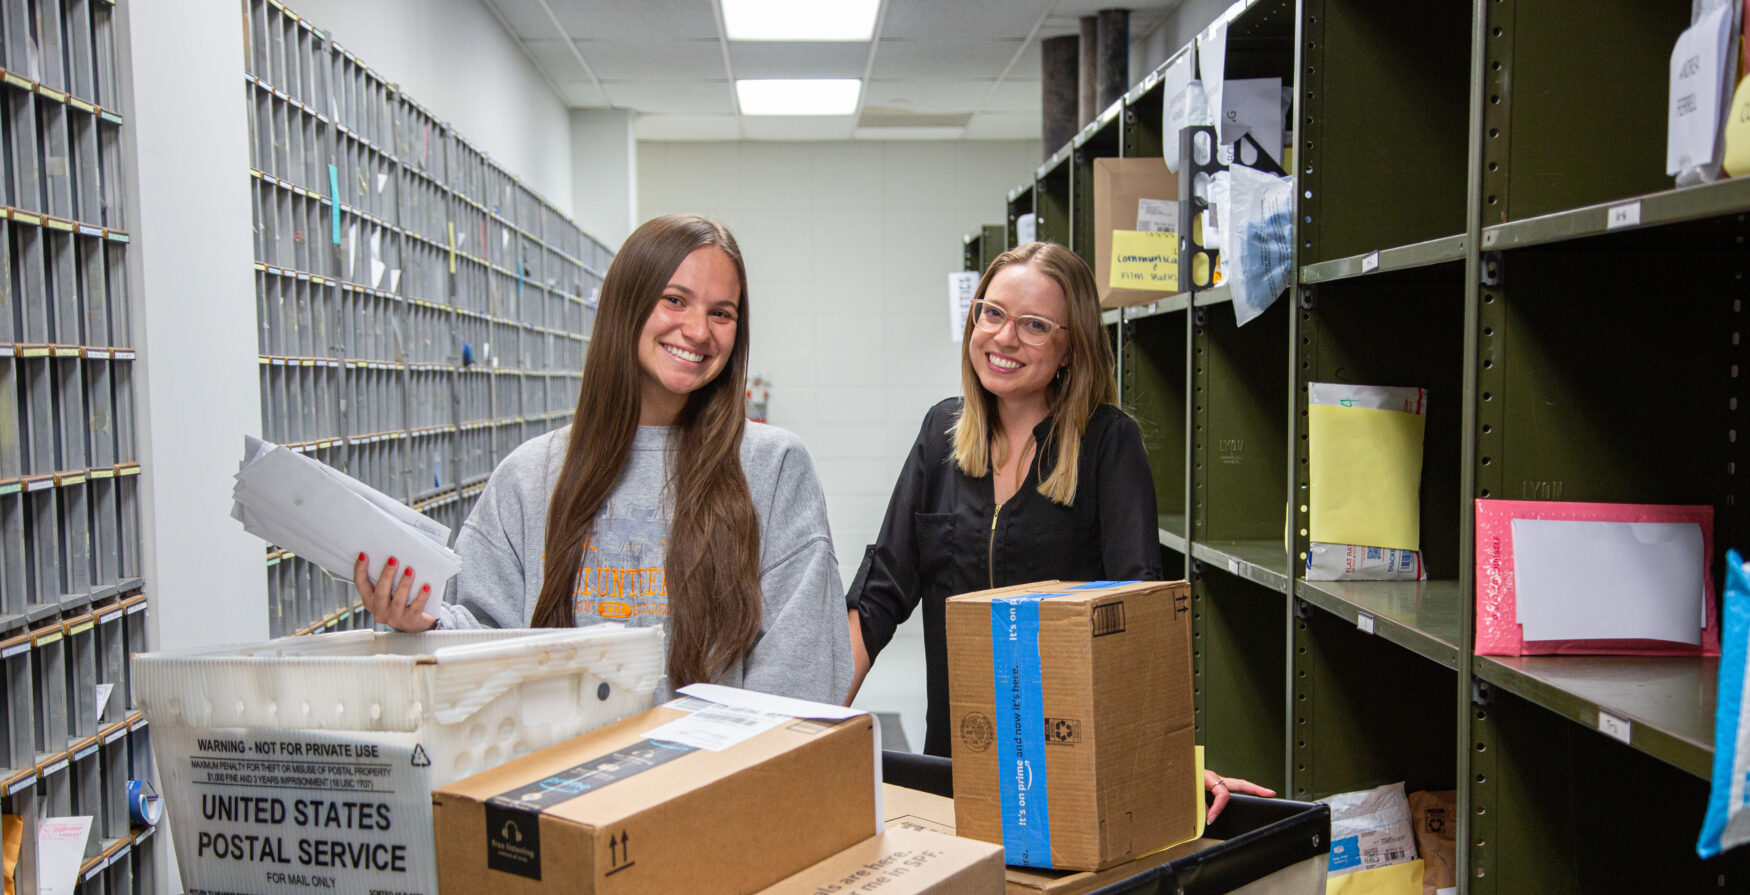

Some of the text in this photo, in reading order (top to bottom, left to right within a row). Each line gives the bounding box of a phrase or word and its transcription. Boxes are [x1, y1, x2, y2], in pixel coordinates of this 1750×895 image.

[1345, 557, 1353, 573] FLAT
[1009, 607, 1017, 621] on
[1009, 624, 1018, 641] It's
[1011, 665, 1019, 692] here.
[1013, 694, 1021, 710] it's
[197, 738, 246, 753] WARNING
[254, 741, 277, 755] NOT
[280, 742, 303, 756] FOR
[305, 743, 353, 757] PRIVATE
[355, 744, 379, 758] USE
[1013, 738, 1023, 757] and
[191, 761, 392, 777] MAXIMUM PENALTY FOR THEFT OR MISUSE OF POSTAL PROPERTY
[1016, 760, 1027, 791] prime
[225, 773, 239, 782] FINE
[240, 774, 253, 784] AND
[258, 776, 280, 785] YEARS
[1019, 793, 1026, 807] on
[202, 794, 392, 831] UNITED STATES
[1018, 809, 1027, 826] It's
[198, 832, 407, 873] POSTAL SERVICE
[840, 869, 871, 885] are
[864, 850, 913, 871] here.
[861, 850, 944, 892] me in SPF.
[266, 872, 337, 889] FOR MAIL ONLY
